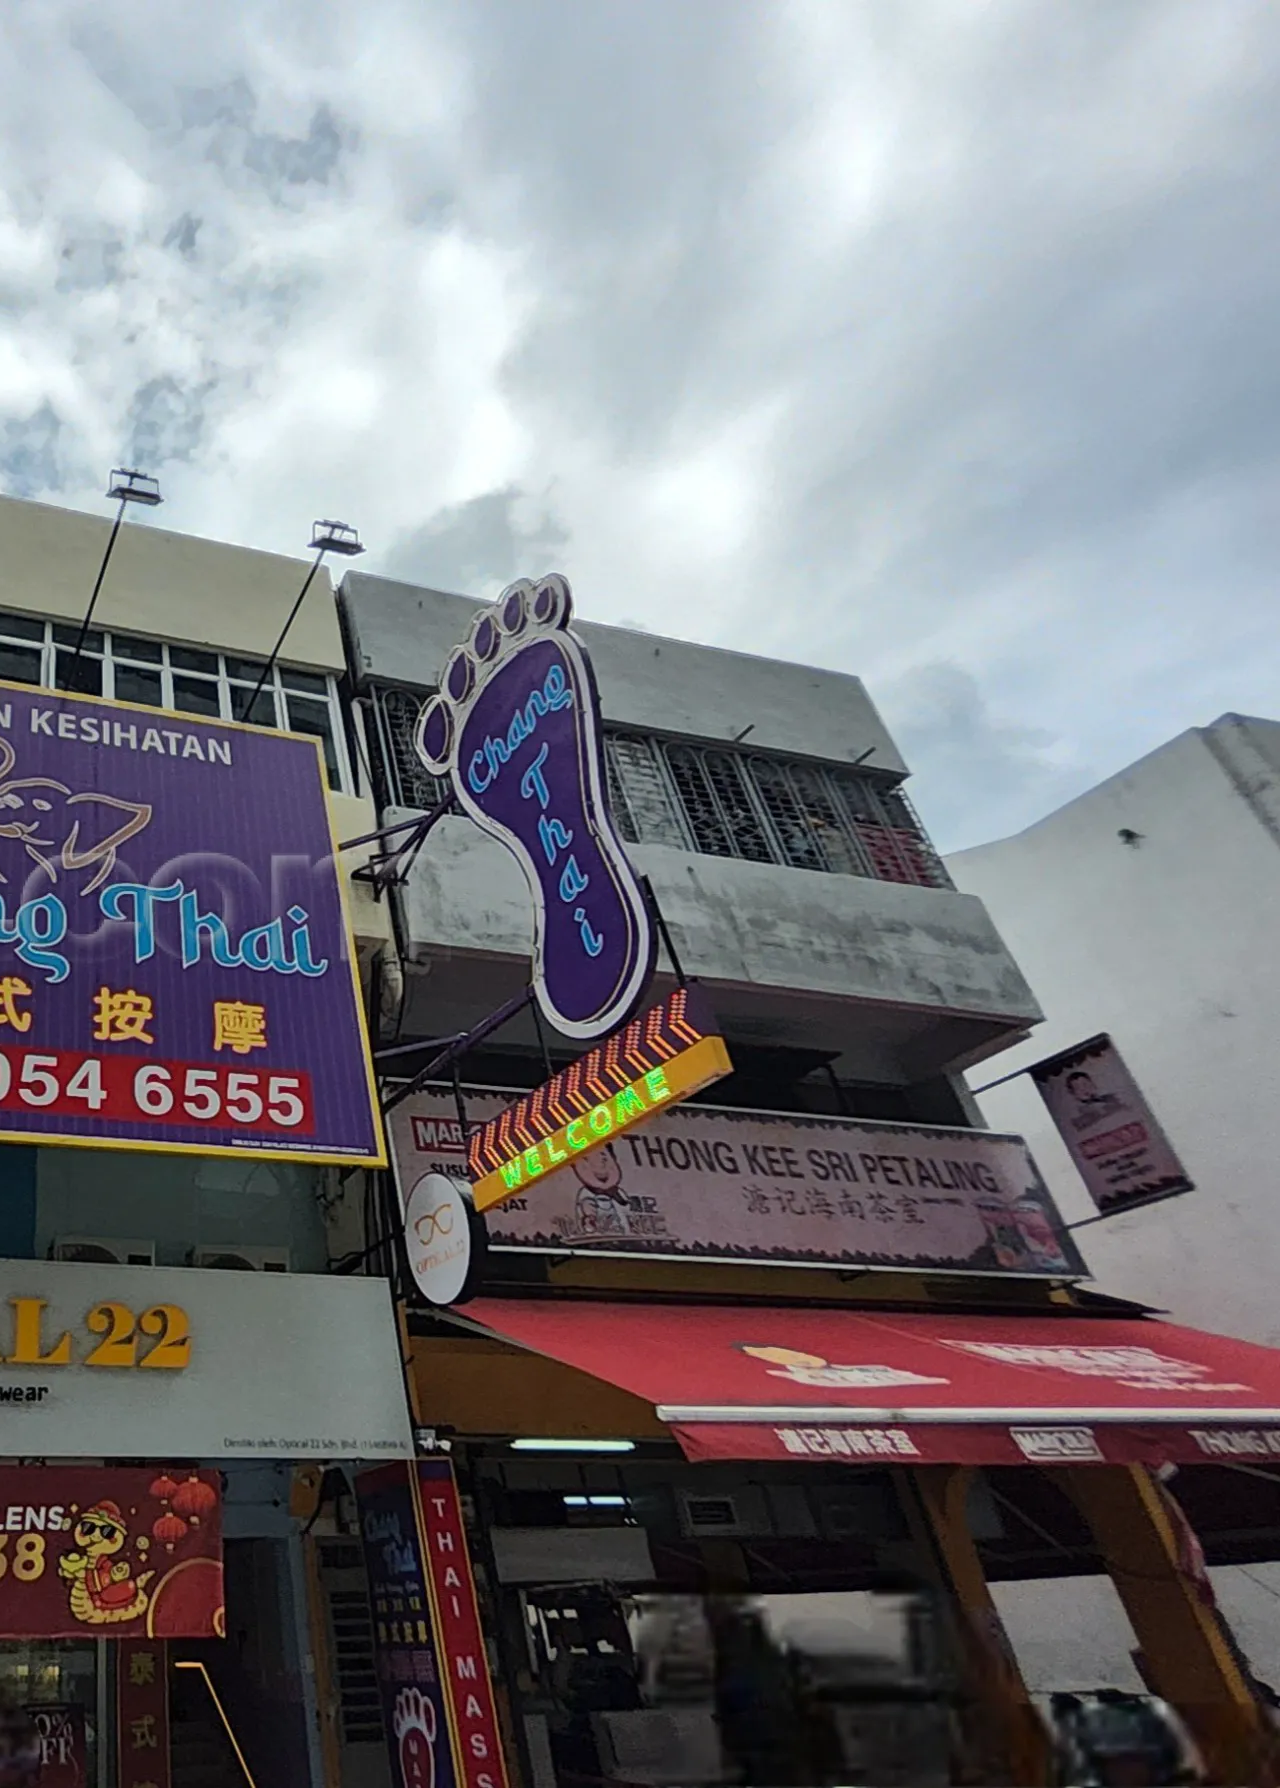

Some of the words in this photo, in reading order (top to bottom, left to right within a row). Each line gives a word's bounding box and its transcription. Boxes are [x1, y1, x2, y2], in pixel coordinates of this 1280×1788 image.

[30, 708, 233, 766] KESIHATAN
[468, 663, 573, 794] Chang
[520, 742, 604, 957] Thai
[99, 877, 329, 978] Thai
[133, 1064, 306, 1128] 6555
[499, 1066, 671, 1189] WELCOME
[622, 1134, 740, 1174] THONG
[741, 1143, 806, 1181] KEE
[808, 1148, 860, 1185] SRI
[860, 1152, 1001, 1194] PETALING
[83, 1302, 193, 1370] 22
[430, 1497, 462, 1619] THAI
[128, 1650, 160, 1788] 泰式
